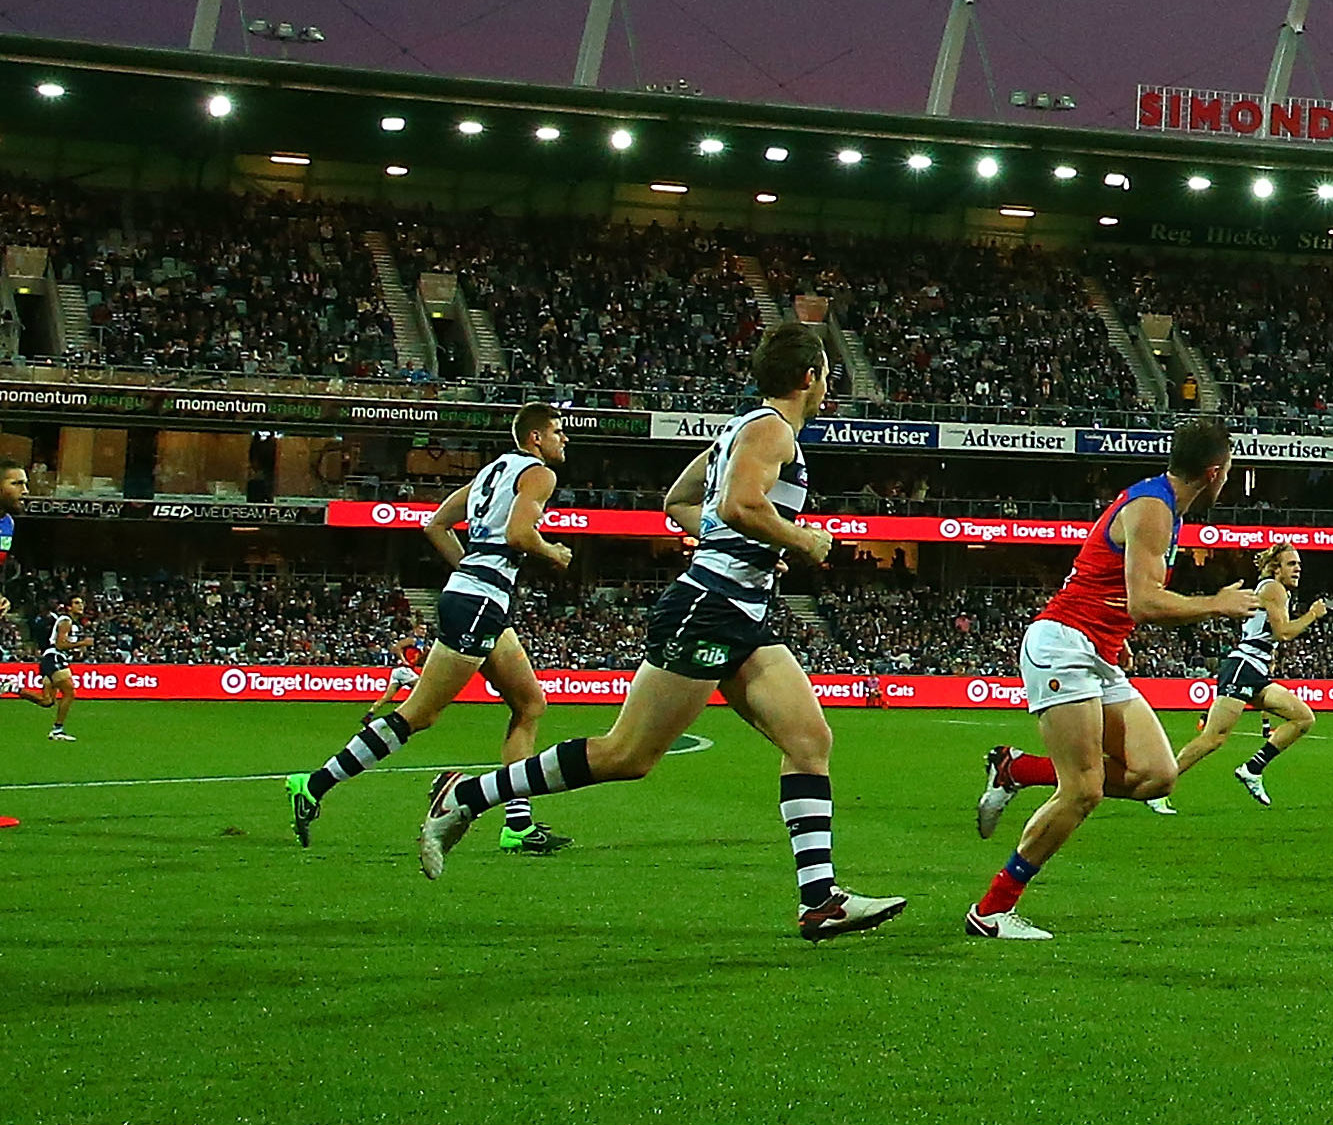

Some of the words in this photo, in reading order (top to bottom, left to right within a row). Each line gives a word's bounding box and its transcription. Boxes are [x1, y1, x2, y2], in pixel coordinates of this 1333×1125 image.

[1150, 223, 1192, 245] Reg
[89, 394, 145, 410] energy
[175, 396, 267, 414] momentum
[268, 403, 322, 420] energy
[351, 406, 439, 422] momentum
[440, 410, 492, 426] energy
[559, 413, 598, 428] ntum
[599, 416, 649, 432] energy
[822, 424, 930, 446] Advertiser
[962, 430, 1066, 450] Advertiser
[1099, 433, 1172, 454] Adverti
[1234, 438, 1330, 459] Advertiser
[474, 461, 508, 519] 9
[153, 505, 184, 518] ISC
[396, 507, 436, 526] Targ
[544, 512, 588, 529] Cats
[826, 518, 868, 534] Cats
[961, 522, 1007, 541] Target
[1012, 523, 1056, 538] loves
[1061, 525, 1088, 539] the
[1219, 529, 1263, 547] Target
[1268, 530, 1309, 544] loves
[696, 646, 727, 666] nib
[83, 671, 117, 689] the
[125, 674, 158, 688] Cats
[249, 672, 302, 696] Target
[304, 673, 353, 691] loves
[355, 676, 387, 693] the
[564, 678, 610, 693] loves
[887, 683, 914, 697] Cats
[988, 682, 1028, 704] Targe
[1297, 686, 1324, 702] the
